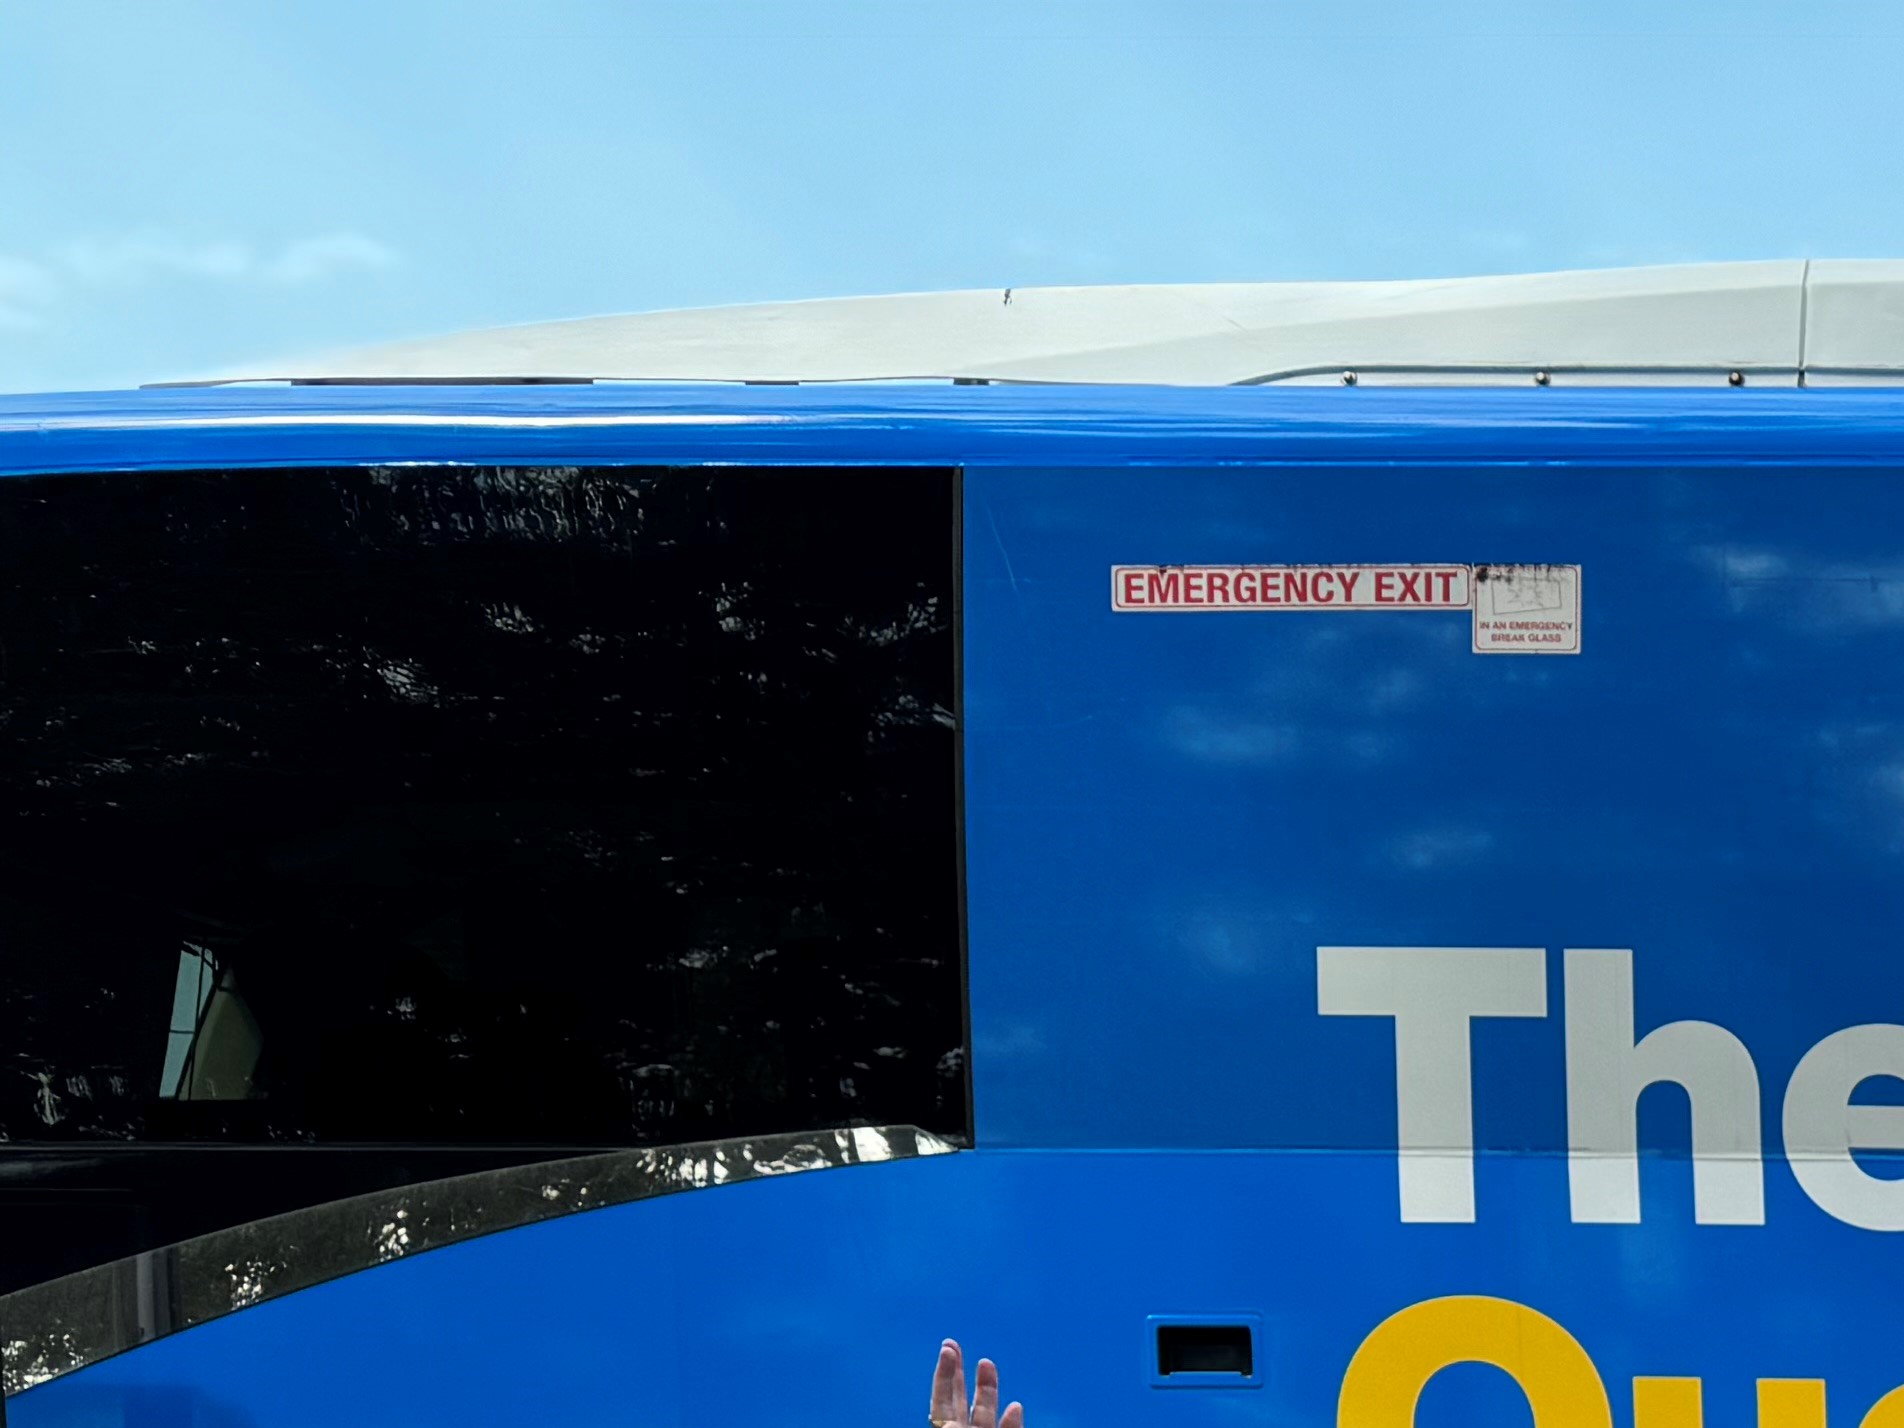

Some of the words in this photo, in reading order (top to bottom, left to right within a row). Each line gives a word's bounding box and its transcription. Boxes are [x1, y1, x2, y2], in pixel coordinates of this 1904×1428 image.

[1123, 571, 1360, 604] EMERGENCY
[1373, 570, 1458, 604] EXIT
[1509, 621, 1573, 631] EMERGENCY
[1491, 633, 1525, 643] BREAK
[1528, 633, 1561, 643] GLASS
